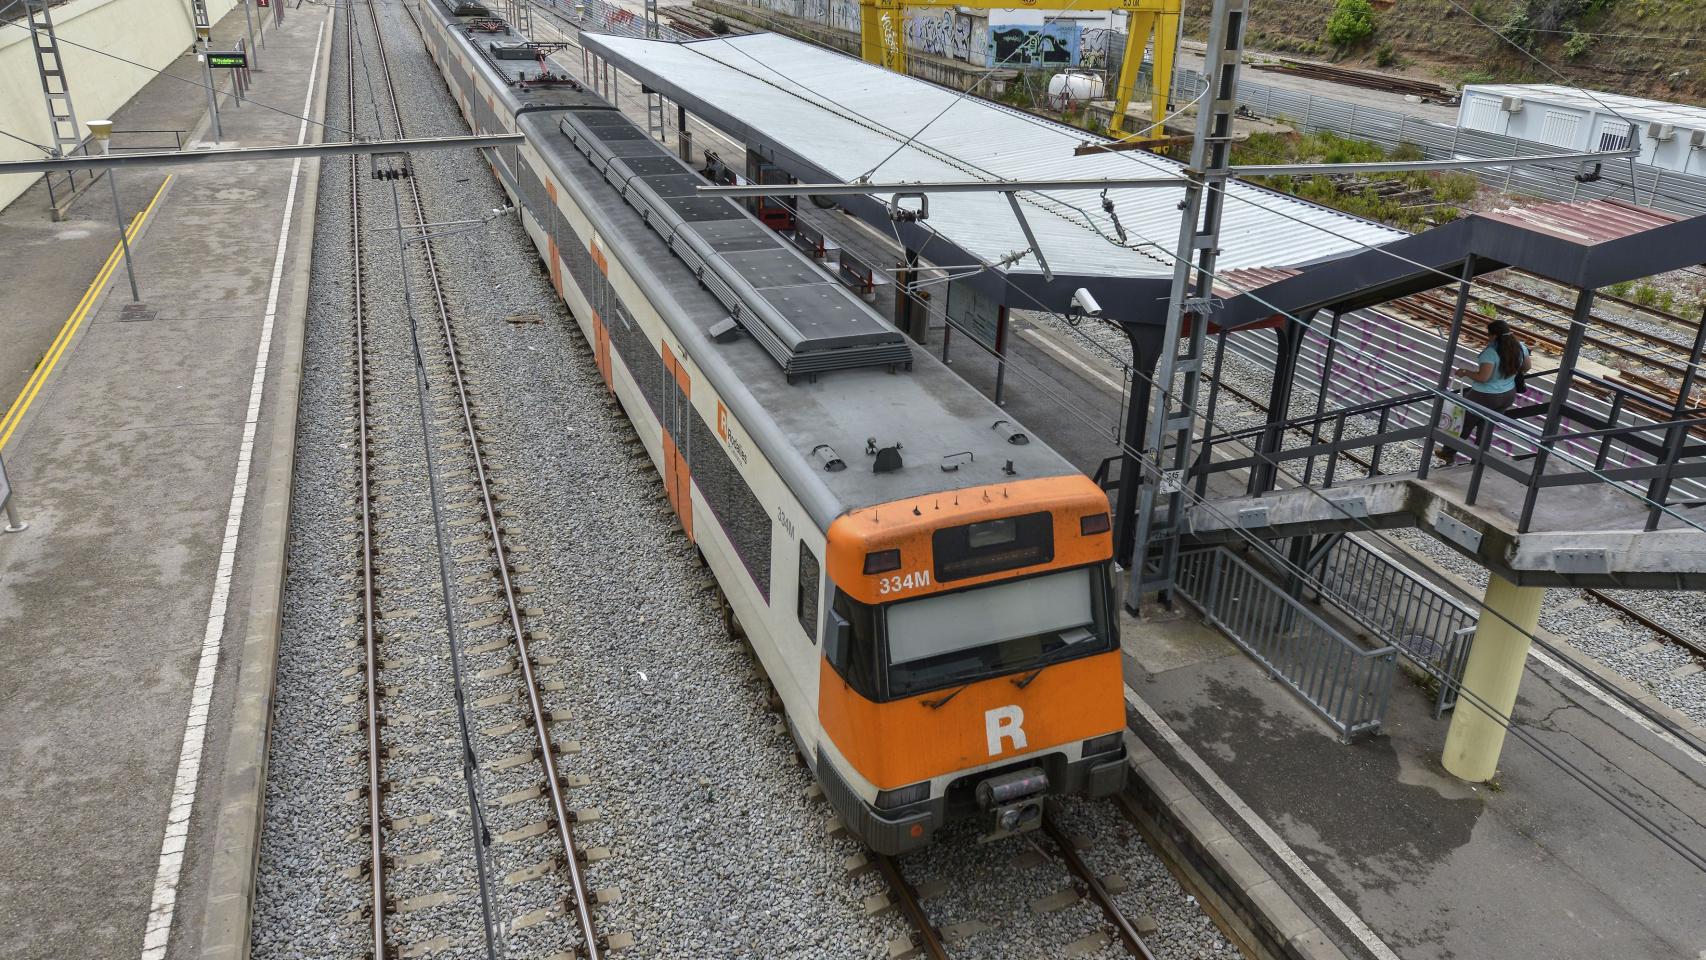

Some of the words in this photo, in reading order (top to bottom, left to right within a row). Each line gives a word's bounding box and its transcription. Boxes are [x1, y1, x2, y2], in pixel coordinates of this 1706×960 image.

[778, 506, 795, 541] 334M
[879, 570, 931, 595] 334M
[985, 704, 1028, 757] R
